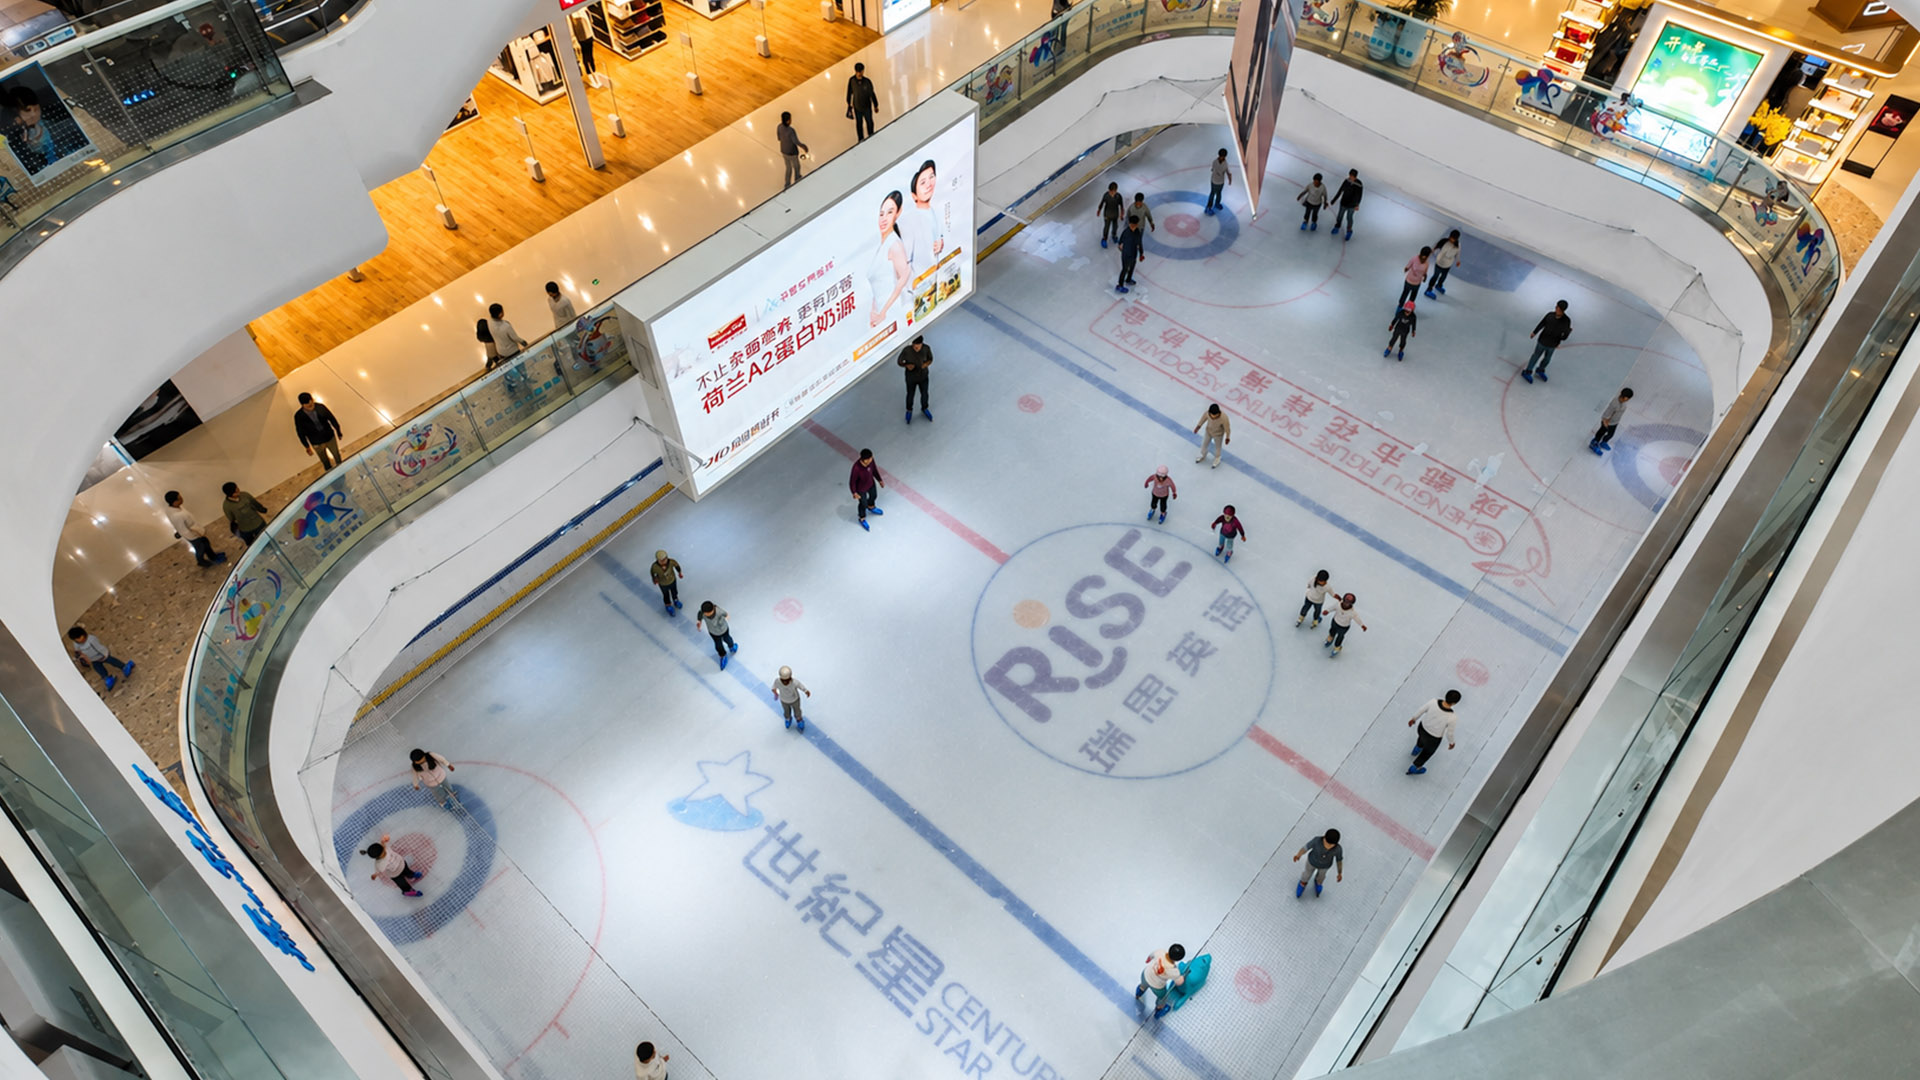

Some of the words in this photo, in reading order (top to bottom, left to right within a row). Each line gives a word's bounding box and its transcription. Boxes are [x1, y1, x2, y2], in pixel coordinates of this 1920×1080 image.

[700, 294, 857, 415] 荷兰A2蛋白奶源
[1310, 435, 1380, 478] FIGURE
[983, 528, 1193, 724] RISE
[1078, 588, 1255, 774] 瑞思英语
[915, 1006, 993, 1080] STAR
[941, 981, 1065, 1080] CENTUR
